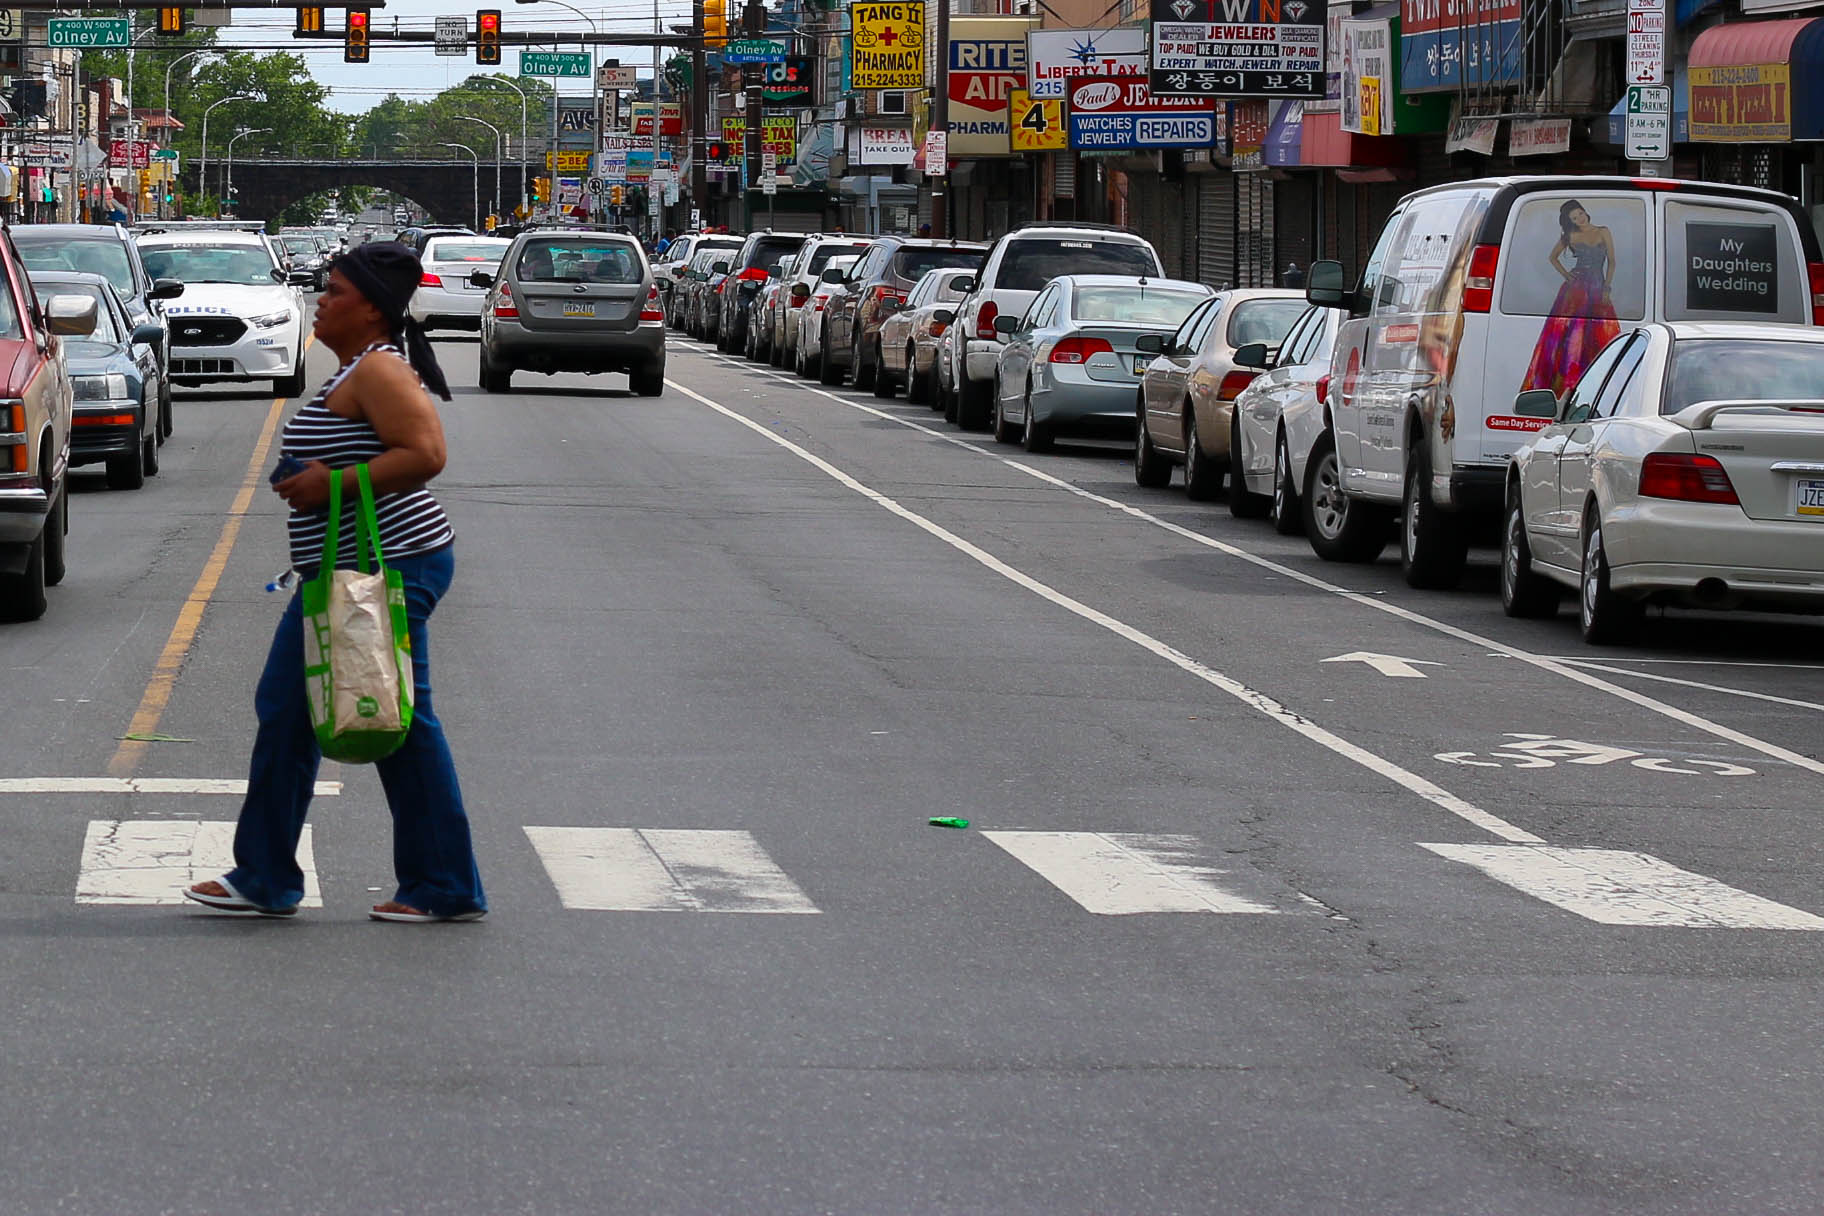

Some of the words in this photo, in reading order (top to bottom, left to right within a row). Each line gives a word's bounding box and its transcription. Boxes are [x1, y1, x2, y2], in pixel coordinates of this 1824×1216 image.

[1639, 0, 1655, 7] ZONE
[856, 5, 903, 24] TANG
[66, 21, 82, 29] 400
[84, 21, 95, 29] W
[95, 21, 111, 29] 500
[1160, 26, 1182, 34] OMEGA
[1183, 26, 1205, 34] WATCH
[1630, 14, 1643, 32] NO
[1643, 17, 1662, 29] PARKING
[53, 31, 98, 48] Olney
[106, 31, 124, 43] Av
[1207, 26, 1276, 41] JEWELERS
[736, 46, 766, 56] Olney
[770, 46, 783, 55] Av
[1159, 43, 1175, 54] TOP
[1177, 44, 1196, 55] PAID!
[1198, 44, 1212, 55] WE
[1213, 44, 1229, 56] BUY
[1231, 45, 1251, 56] GOLD
[1253, 45, 1260, 56] &
[1263, 46, 1277, 57] DIA.
[1281, 46, 1297, 57] TOP
[1298, 46, 1319, 57] PAID!
[1631, 42, 1661, 50] CLEANING
[855, 49, 921, 71] PHARMACY
[958, 43, 1026, 67] RITE
[1632, 51, 1659, 59] THURSDAY
[524, 63, 564, 75] Olney
[570, 64, 586, 74] Av
[1035, 61, 1100, 79] LIBERTY
[1102, 59, 1139, 76] TAX
[1159, 58, 1197, 69] EXPERT
[1286, 60, 1320, 71] REPAIR
[607, 70, 627, 81] 5TH
[854, 73, 923, 86] 215-224-3333
[1262, 73, 1313, 92] 보석
[965, 76, 1020, 101] AID
[1076, 85, 1118, 107] Paul's
[1630, 91, 1638, 110] 2
[1649, 90, 1661, 100] HR
[1641, 102, 1668, 111] PARKING
[1737, 84, 1771, 123] PIZZA
[1020, 101, 1048, 133] 4
[1077, 117, 1132, 131] WATCHES
[1630, 119, 1634, 128] 8
[1656, 119, 1666, 129] PM
[723, 127, 769, 142] INCE
[770, 127, 794, 140] TAX
[863, 129, 912, 144] BREA
[1139, 120, 1208, 140] REPAIRS
[605, 136, 627, 150] NAILS
[1077, 132, 1133, 146] JEWELRY
[1720, 238, 1744, 255] My
[1692, 256, 1773, 274] Daughters
[1696, 276, 1768, 295] Wedding
[167, 306, 233, 315] OLICE
[1490, 417, 1511, 427] Same
[1511, 418, 1524, 429] Day
[1524, 419, 1551, 430] Service
